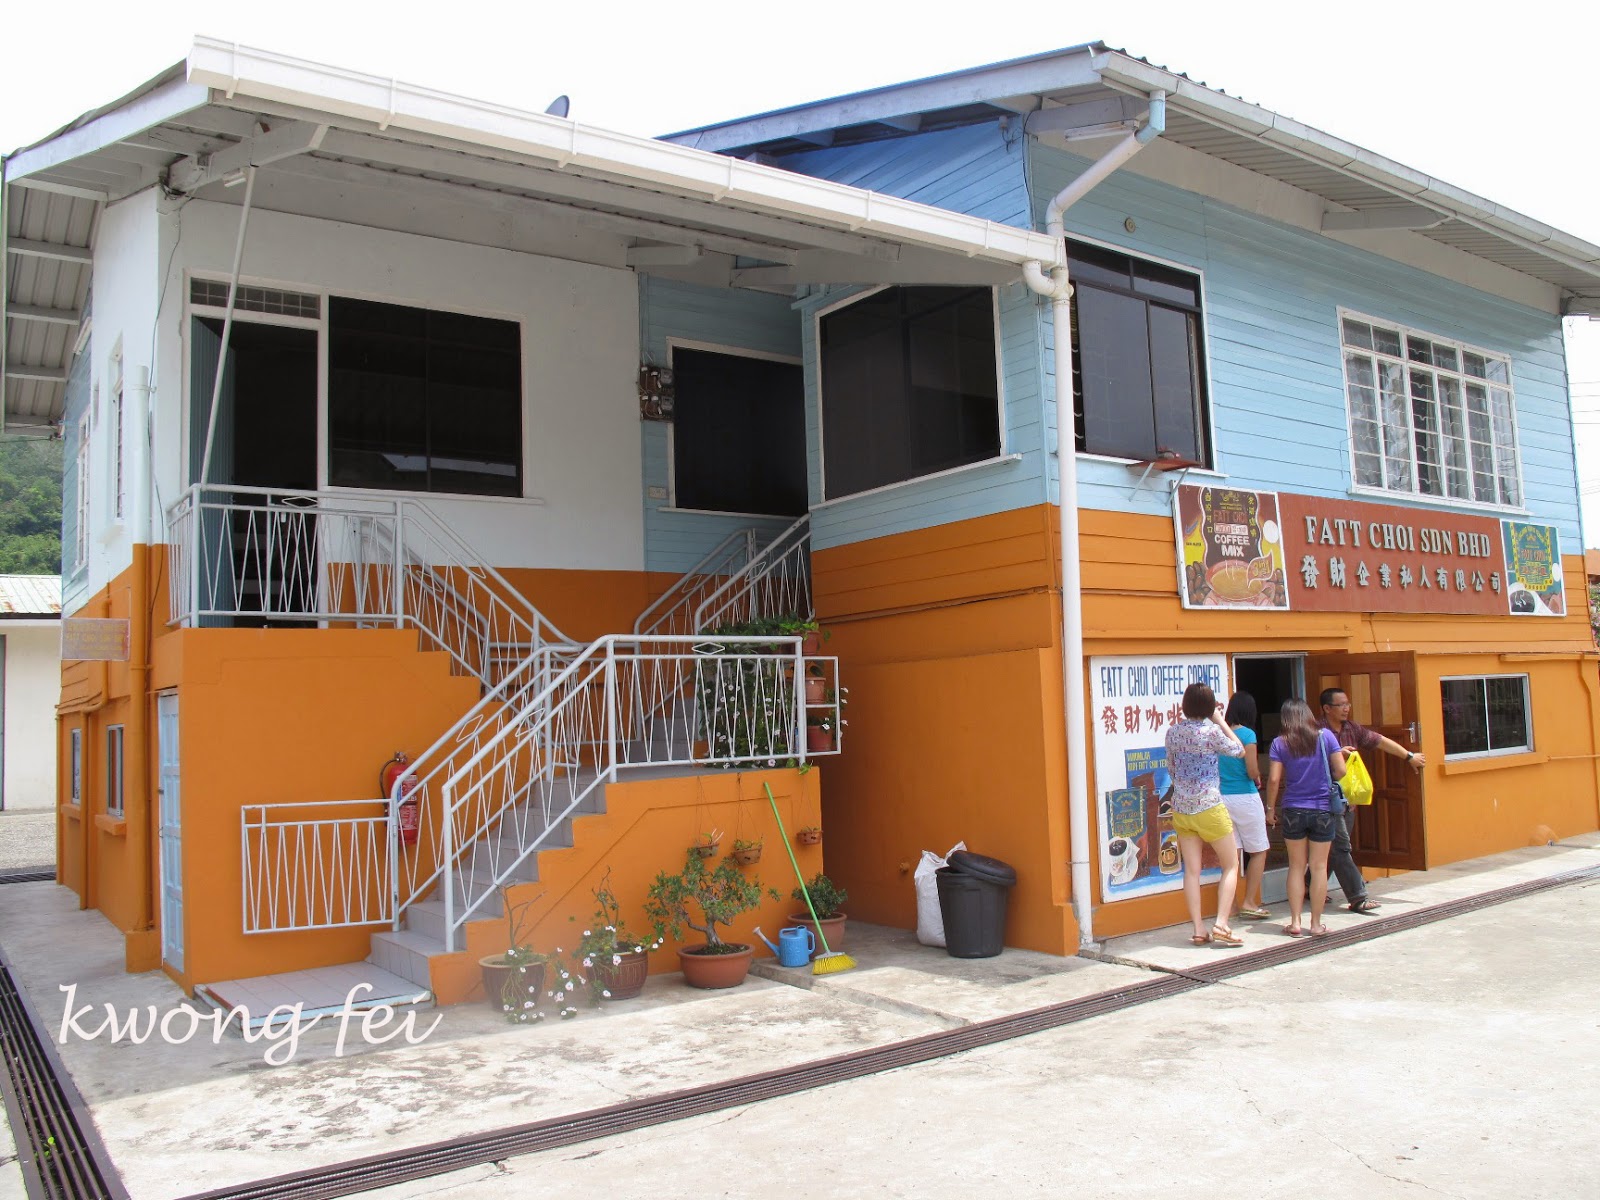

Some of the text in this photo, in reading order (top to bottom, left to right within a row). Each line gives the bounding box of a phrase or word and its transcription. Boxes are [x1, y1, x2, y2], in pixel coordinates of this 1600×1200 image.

[1214, 534, 1250, 545] COFFEE
[1221, 545, 1244, 557] MIX
[1305, 515, 1361, 547] FATT
[1369, 522, 1415, 551] CHOI
[1420, 528, 1453, 554] SDN
[1457, 531, 1491, 558] BHD
[1301, 555, 1500, 594] 發財企業私人有限公司
[1100, 664, 1221, 697] FATT CHOI COFFEE CORNER
